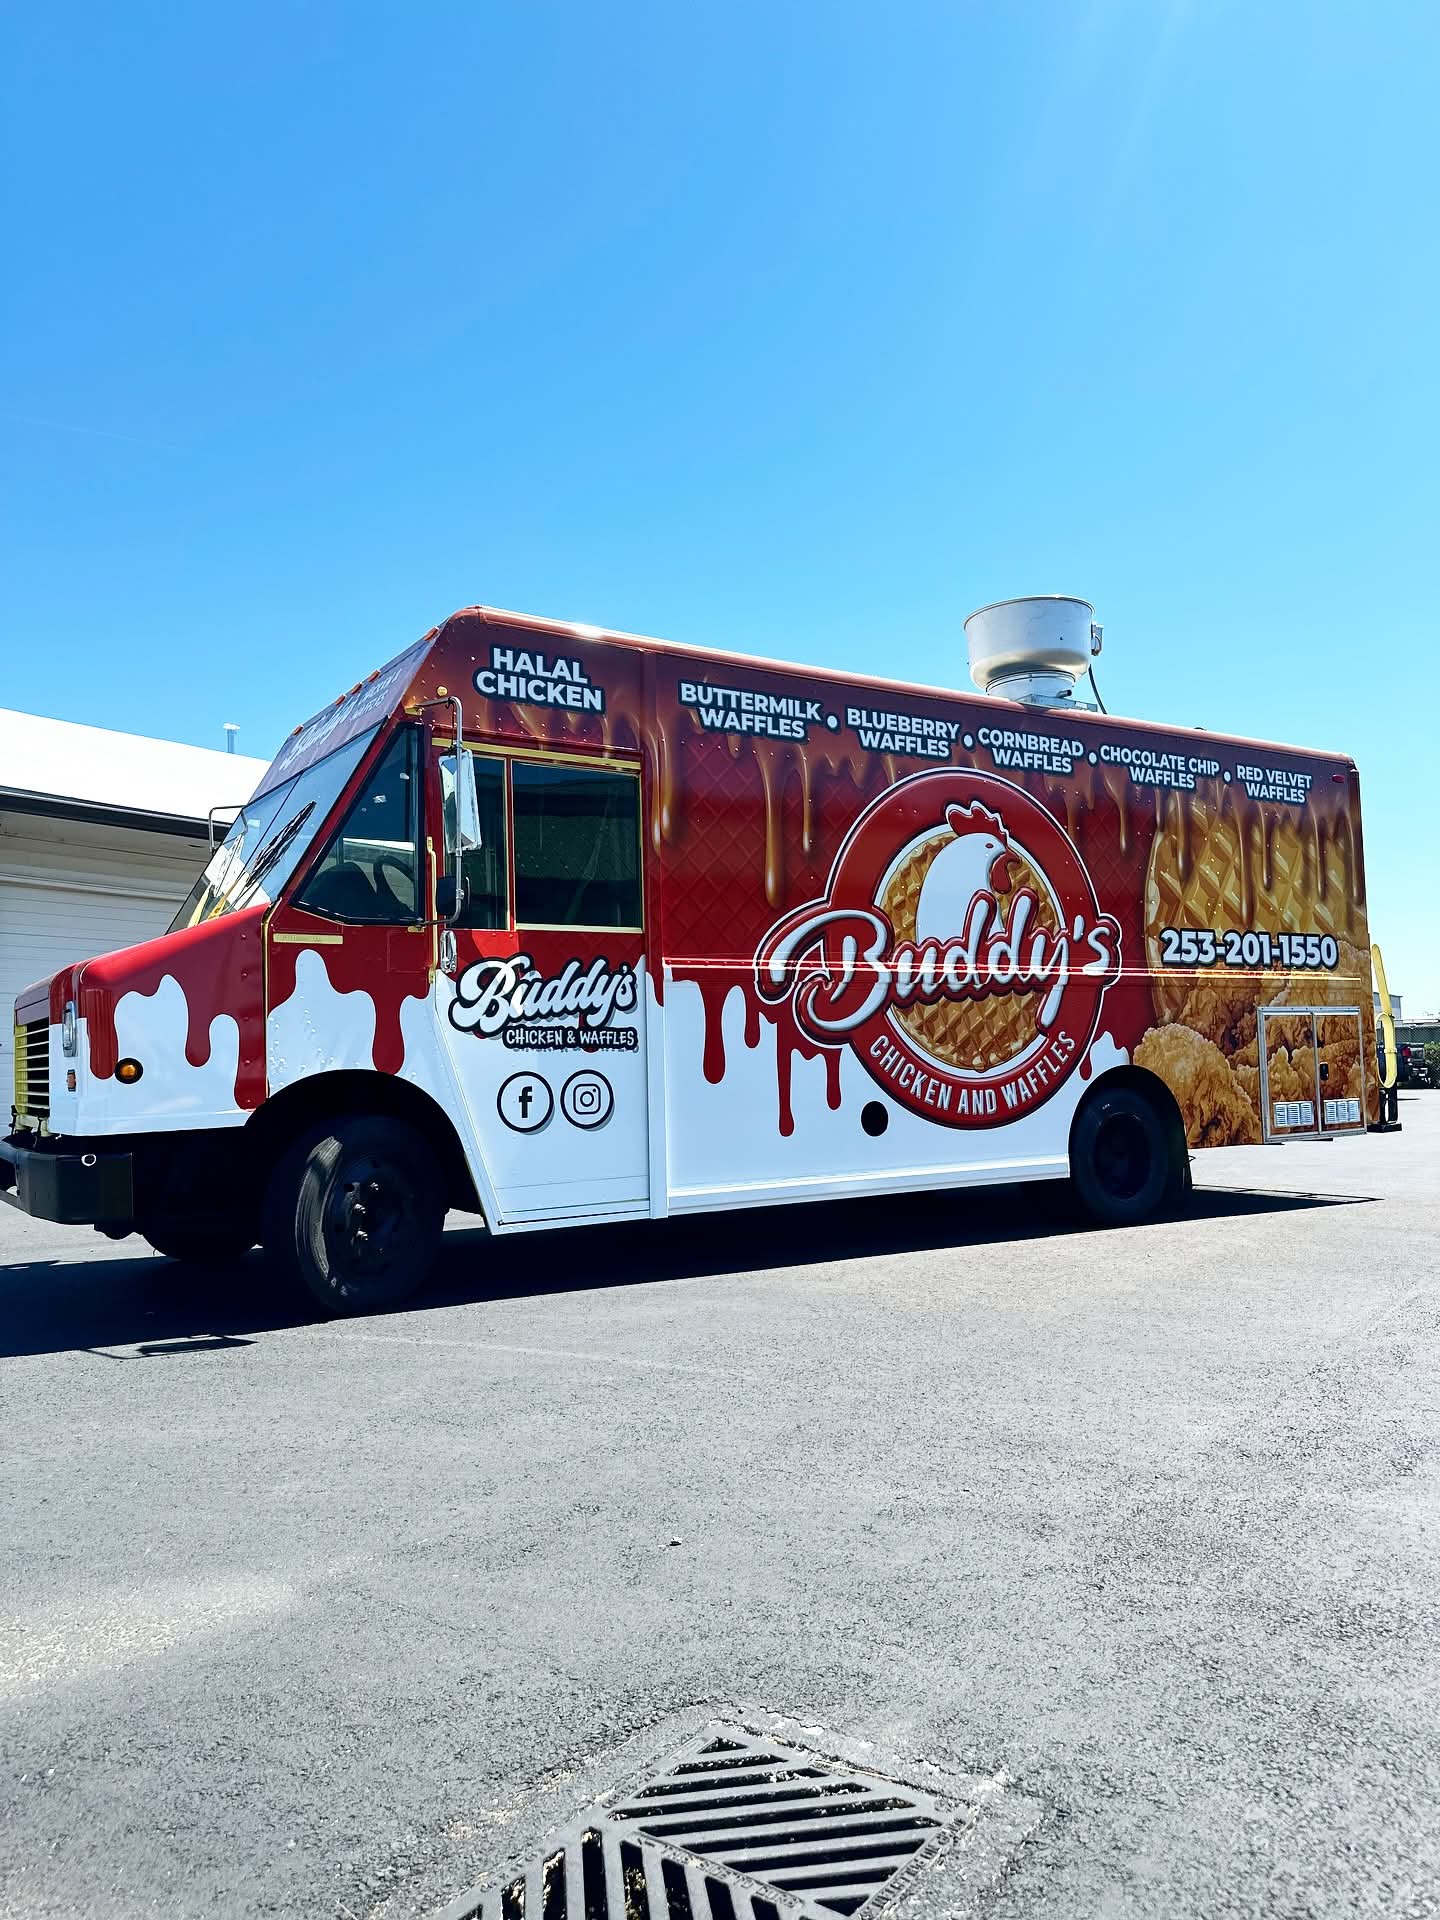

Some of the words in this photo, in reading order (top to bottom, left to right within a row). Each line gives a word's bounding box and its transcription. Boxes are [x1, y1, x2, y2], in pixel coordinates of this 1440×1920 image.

[494, 647, 588, 685] HALAL
[476, 671, 602, 711] CHICKEN
[680, 683, 821, 721] BUTTERMILK
[700, 706, 806, 739] WAFFLES
[847, 709, 959, 740] BLUEBERRY
[859, 729, 950, 757] WAFFLES
[978, 728, 1084, 757] CORNBREAD
[992, 748, 1073, 773] WAFFLES
[1100, 744, 1186, 773] CHOCOLATE
[1187, 758, 1220, 776] CHIP
[1129, 766, 1195, 789] WAFFLES
[1236, 765, 1263, 783] RED
[1265, 770, 1313, 789] VELVET
[1245, 782, 1306, 804] WAFFLES
[769, 894, 1113, 1031] Buddy's
[1160, 929, 1338, 968] 253-201-1550
[451, 954, 634, 1032] Buddy's
[506, 1028, 563, 1046] CHICKEN
[566, 1030, 576, 1045] &
[579, 1029, 635, 1046] WAFFLES
[869, 1034, 952, 1112] CHICKEN
[957, 1088, 998, 1116] AND
[1000, 1030, 1076, 1110] WAFFLES
